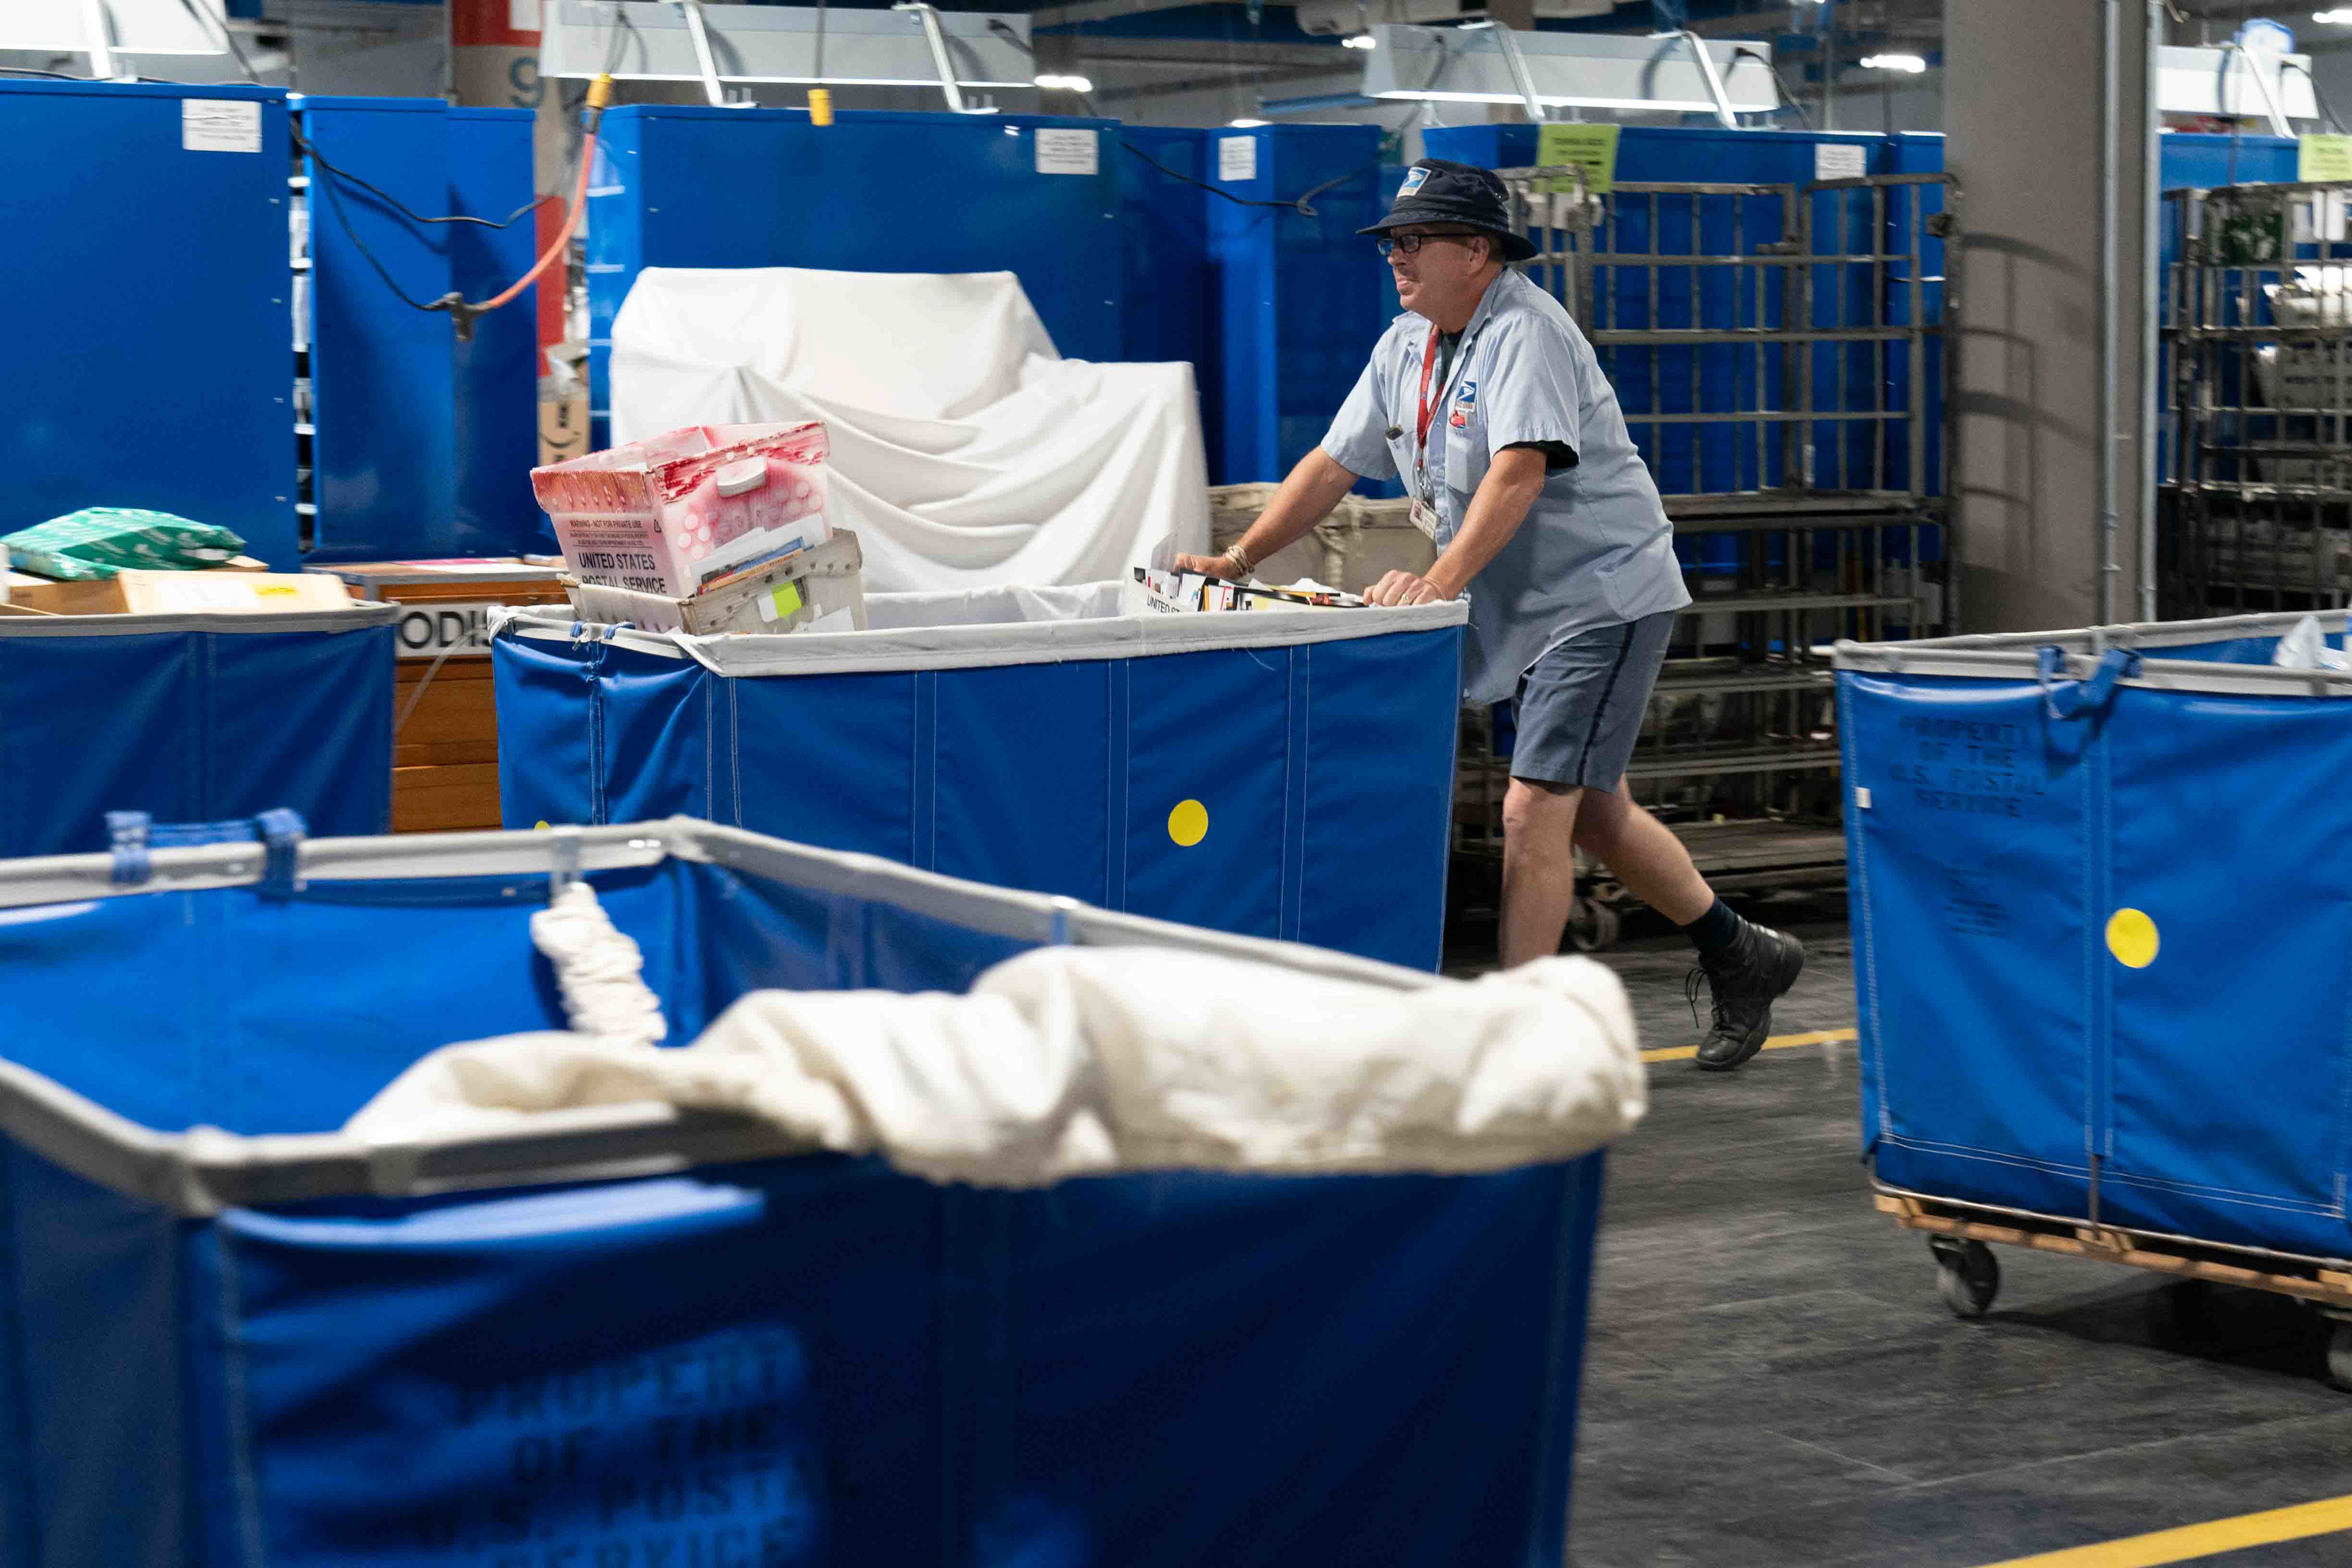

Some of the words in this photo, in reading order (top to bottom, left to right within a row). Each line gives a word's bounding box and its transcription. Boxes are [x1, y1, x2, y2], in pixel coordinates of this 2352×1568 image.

[509, 57, 546, 107] 9
[570, 519, 589, 528] WARNING
[613, 520, 632, 528] PRIVATE
[632, 520, 643, 528] USE
[578, 553, 615, 569] UNITED
[616, 554, 656, 570] STATES
[582, 575, 618, 587] POSTAL
[623, 576, 667, 593] SERVICE
[1147, 594, 1170, 613] UNITED
[1898, 715, 2030, 745] PROPERTY
[1918, 739, 1950, 761] OF
[1966, 745, 2016, 768] THE
[1948, 767, 2044, 795] POSTAL
[1914, 789, 2021, 818] SERVICE
[456, 1335, 828, 1425] PROPERT
[509, 1429, 590, 1486] OF
[643, 1401, 774, 1466] THE
